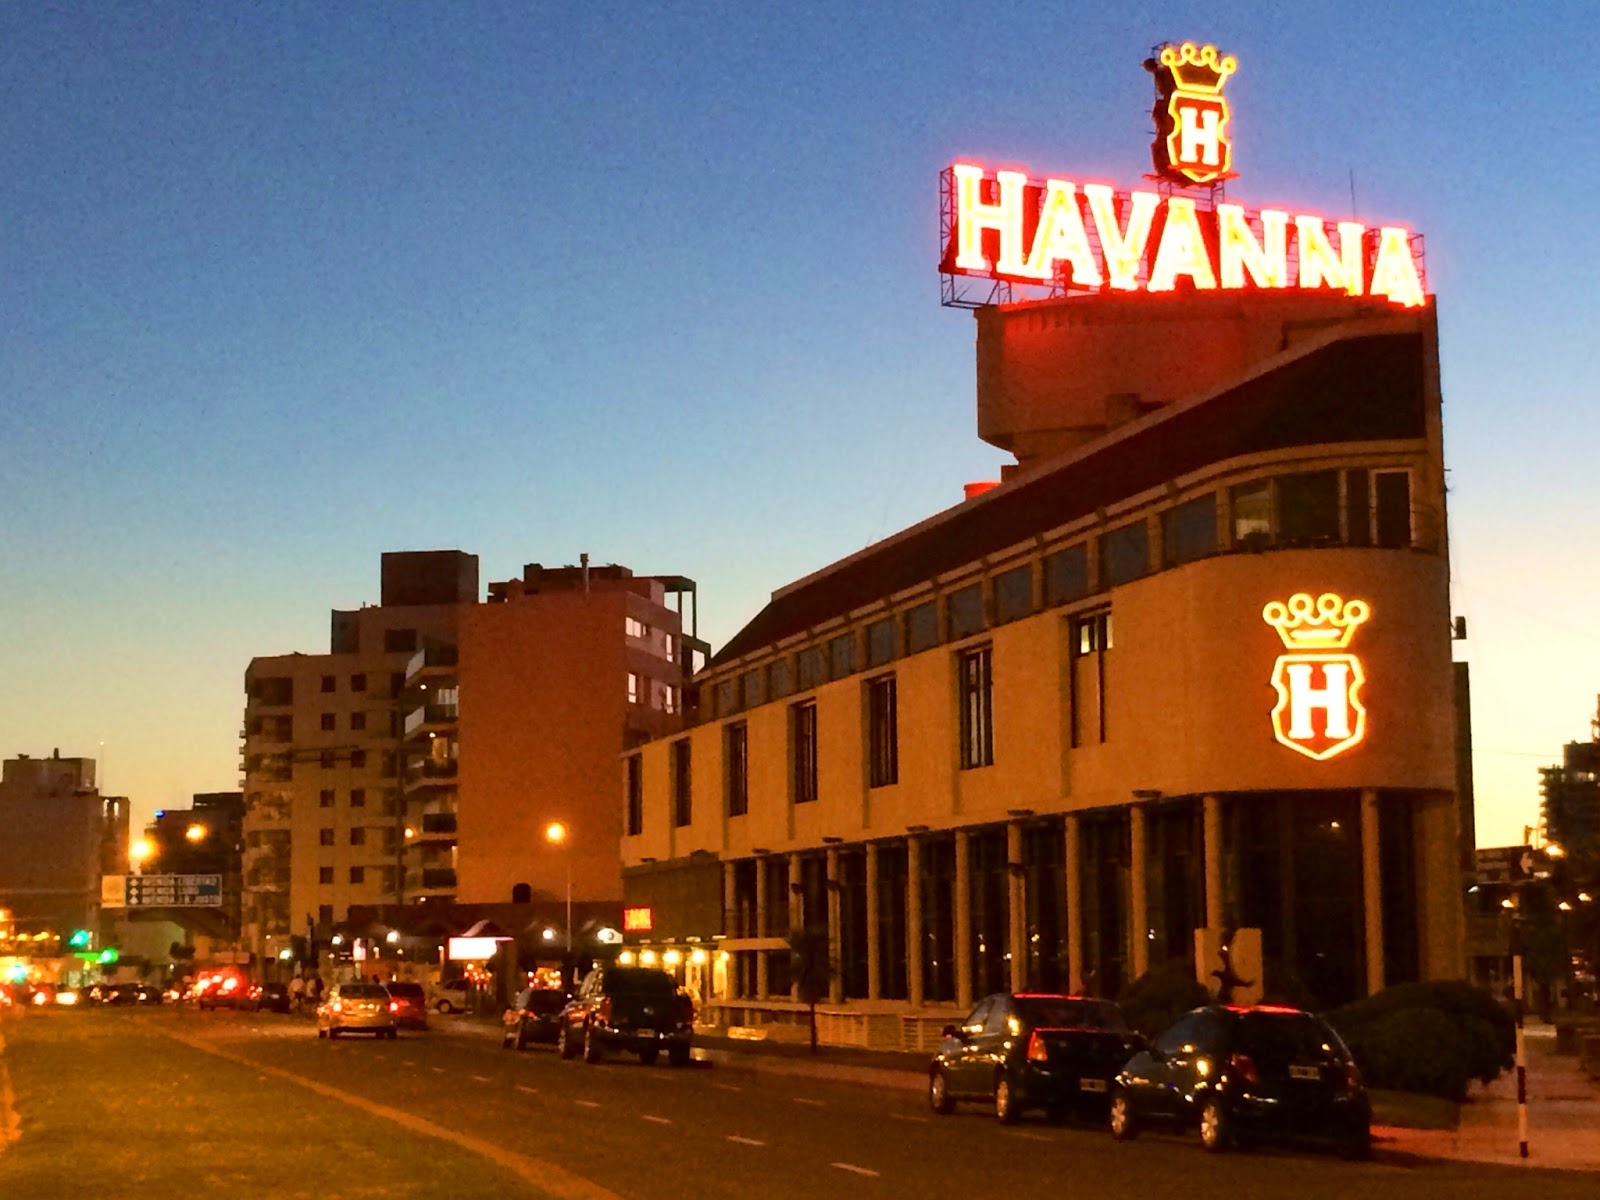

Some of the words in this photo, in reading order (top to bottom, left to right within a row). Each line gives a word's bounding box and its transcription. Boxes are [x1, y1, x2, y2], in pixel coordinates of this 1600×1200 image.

[1180, 107, 1219, 165] H
[953, 164, 1426, 307] HAVANNA
[1287, 664, 1350, 739] H
